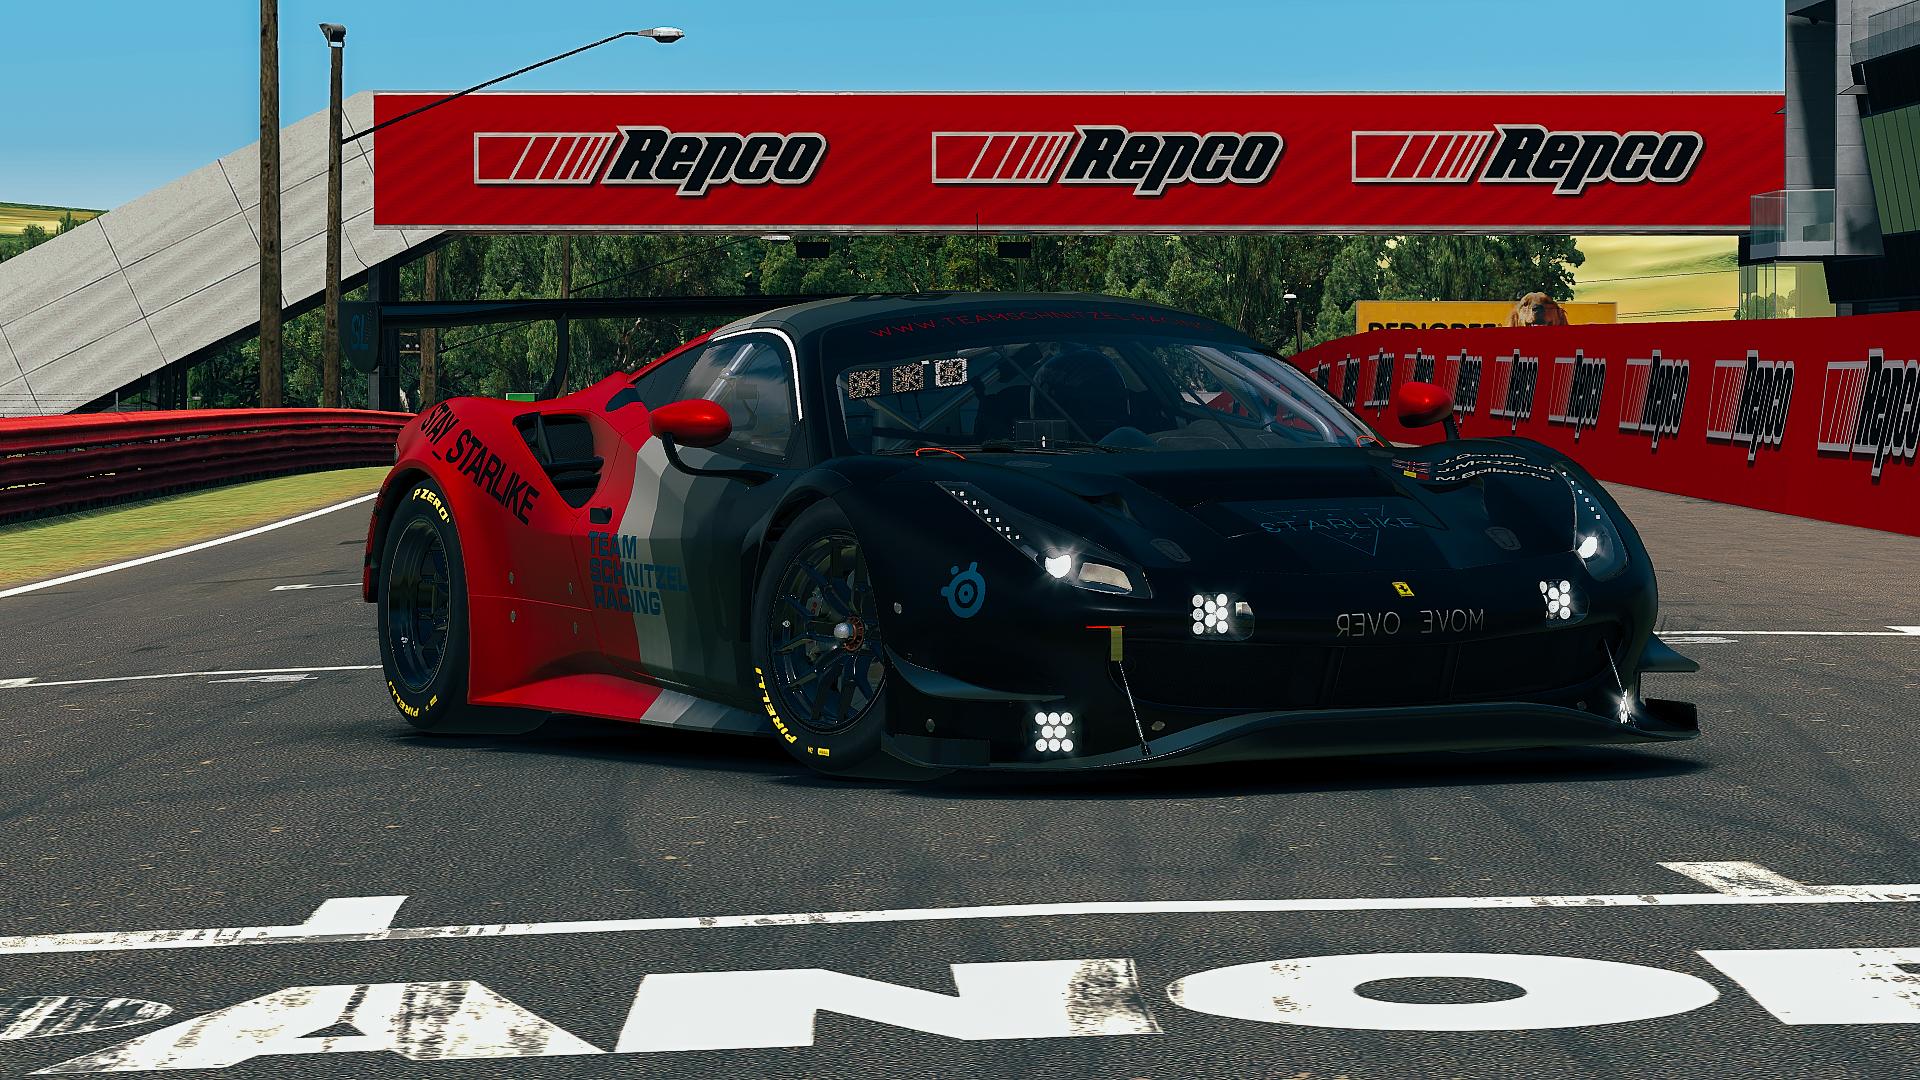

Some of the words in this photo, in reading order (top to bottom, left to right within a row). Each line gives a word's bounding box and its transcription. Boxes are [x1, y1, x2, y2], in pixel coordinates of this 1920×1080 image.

[601, 125, 828, 196] Repco
[1058, 125, 1284, 196] Repco
[1477, 124, 1704, 195] Repco
[1733, 349, 1795, 461] Repco
[589, 531, 637, 559] TEAM
[1260, 517, 1423, 532] STARLIKE
[591, 557, 689, 592] SCHNITZEL
[593, 585, 661, 616] RACING
[755, 667, 798, 744] PIRELLI
